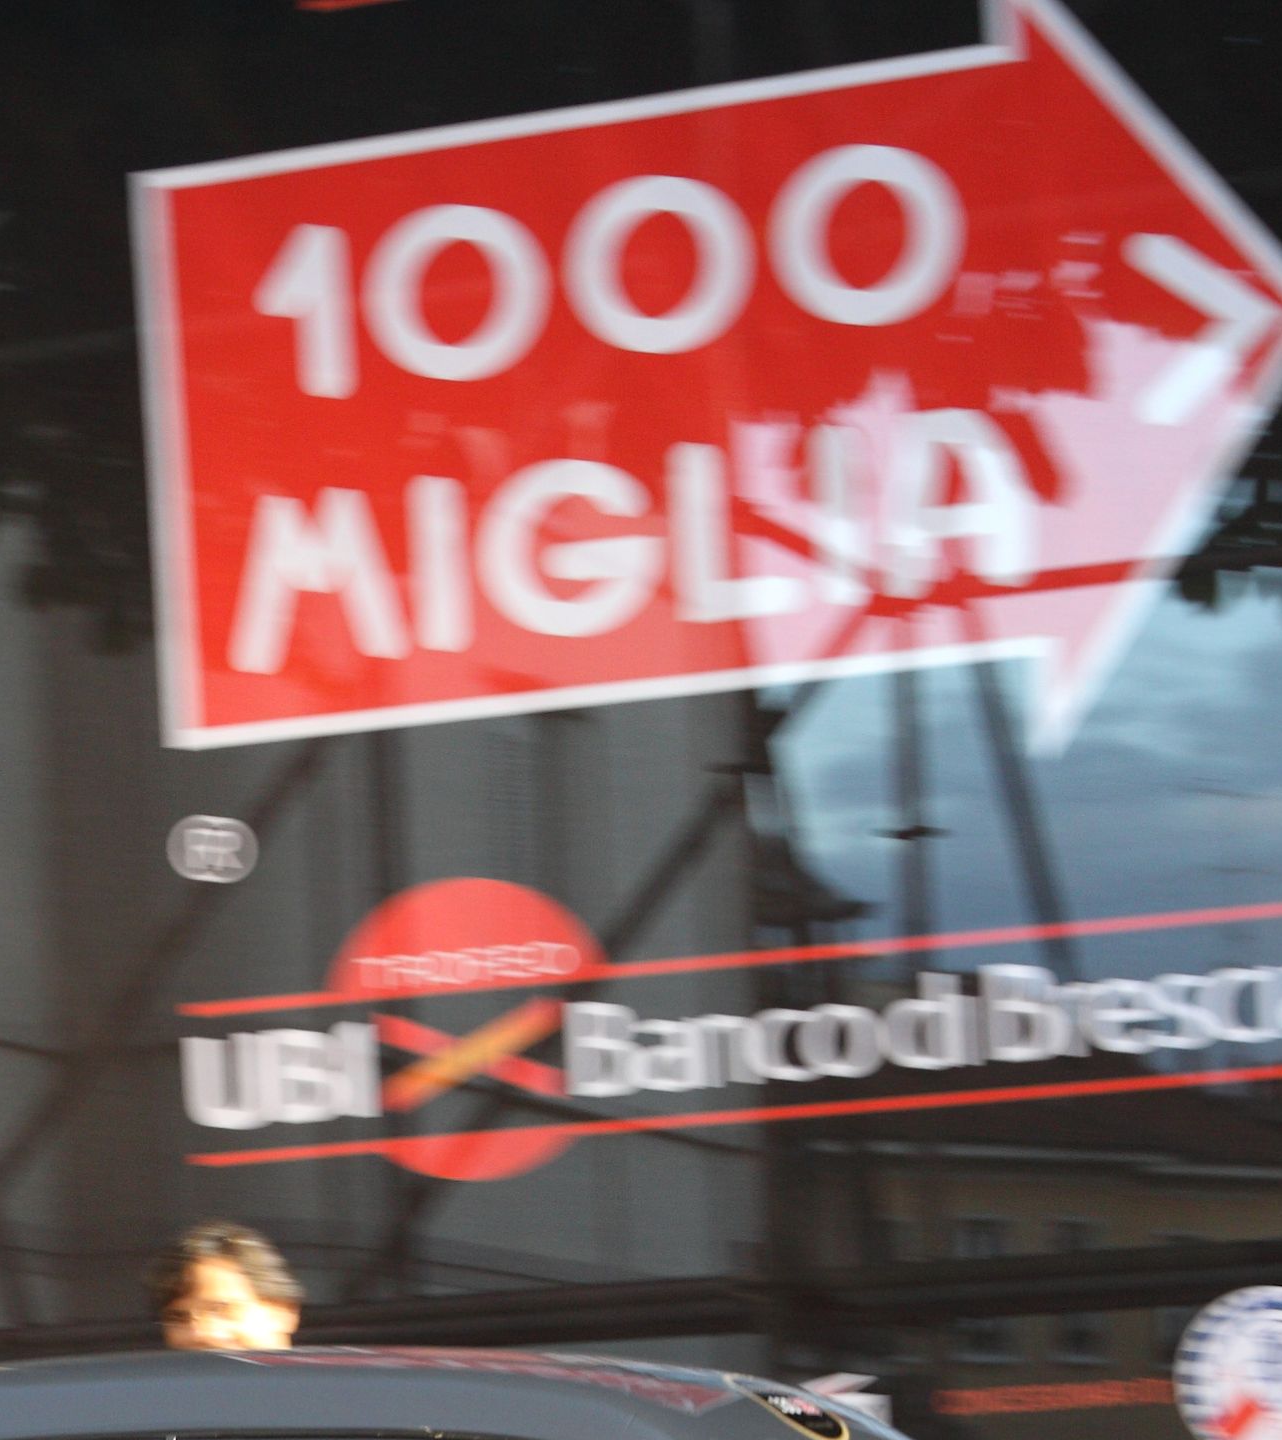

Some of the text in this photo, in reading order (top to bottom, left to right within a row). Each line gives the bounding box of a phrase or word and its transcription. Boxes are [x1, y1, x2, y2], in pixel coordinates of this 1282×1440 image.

[253, 142, 968, 400] 1000
[228, 408, 1036, 676] MIGLIA
[180, 1020, 385, 1131] UBI
[563, 1001, 880, 1098] Banco
